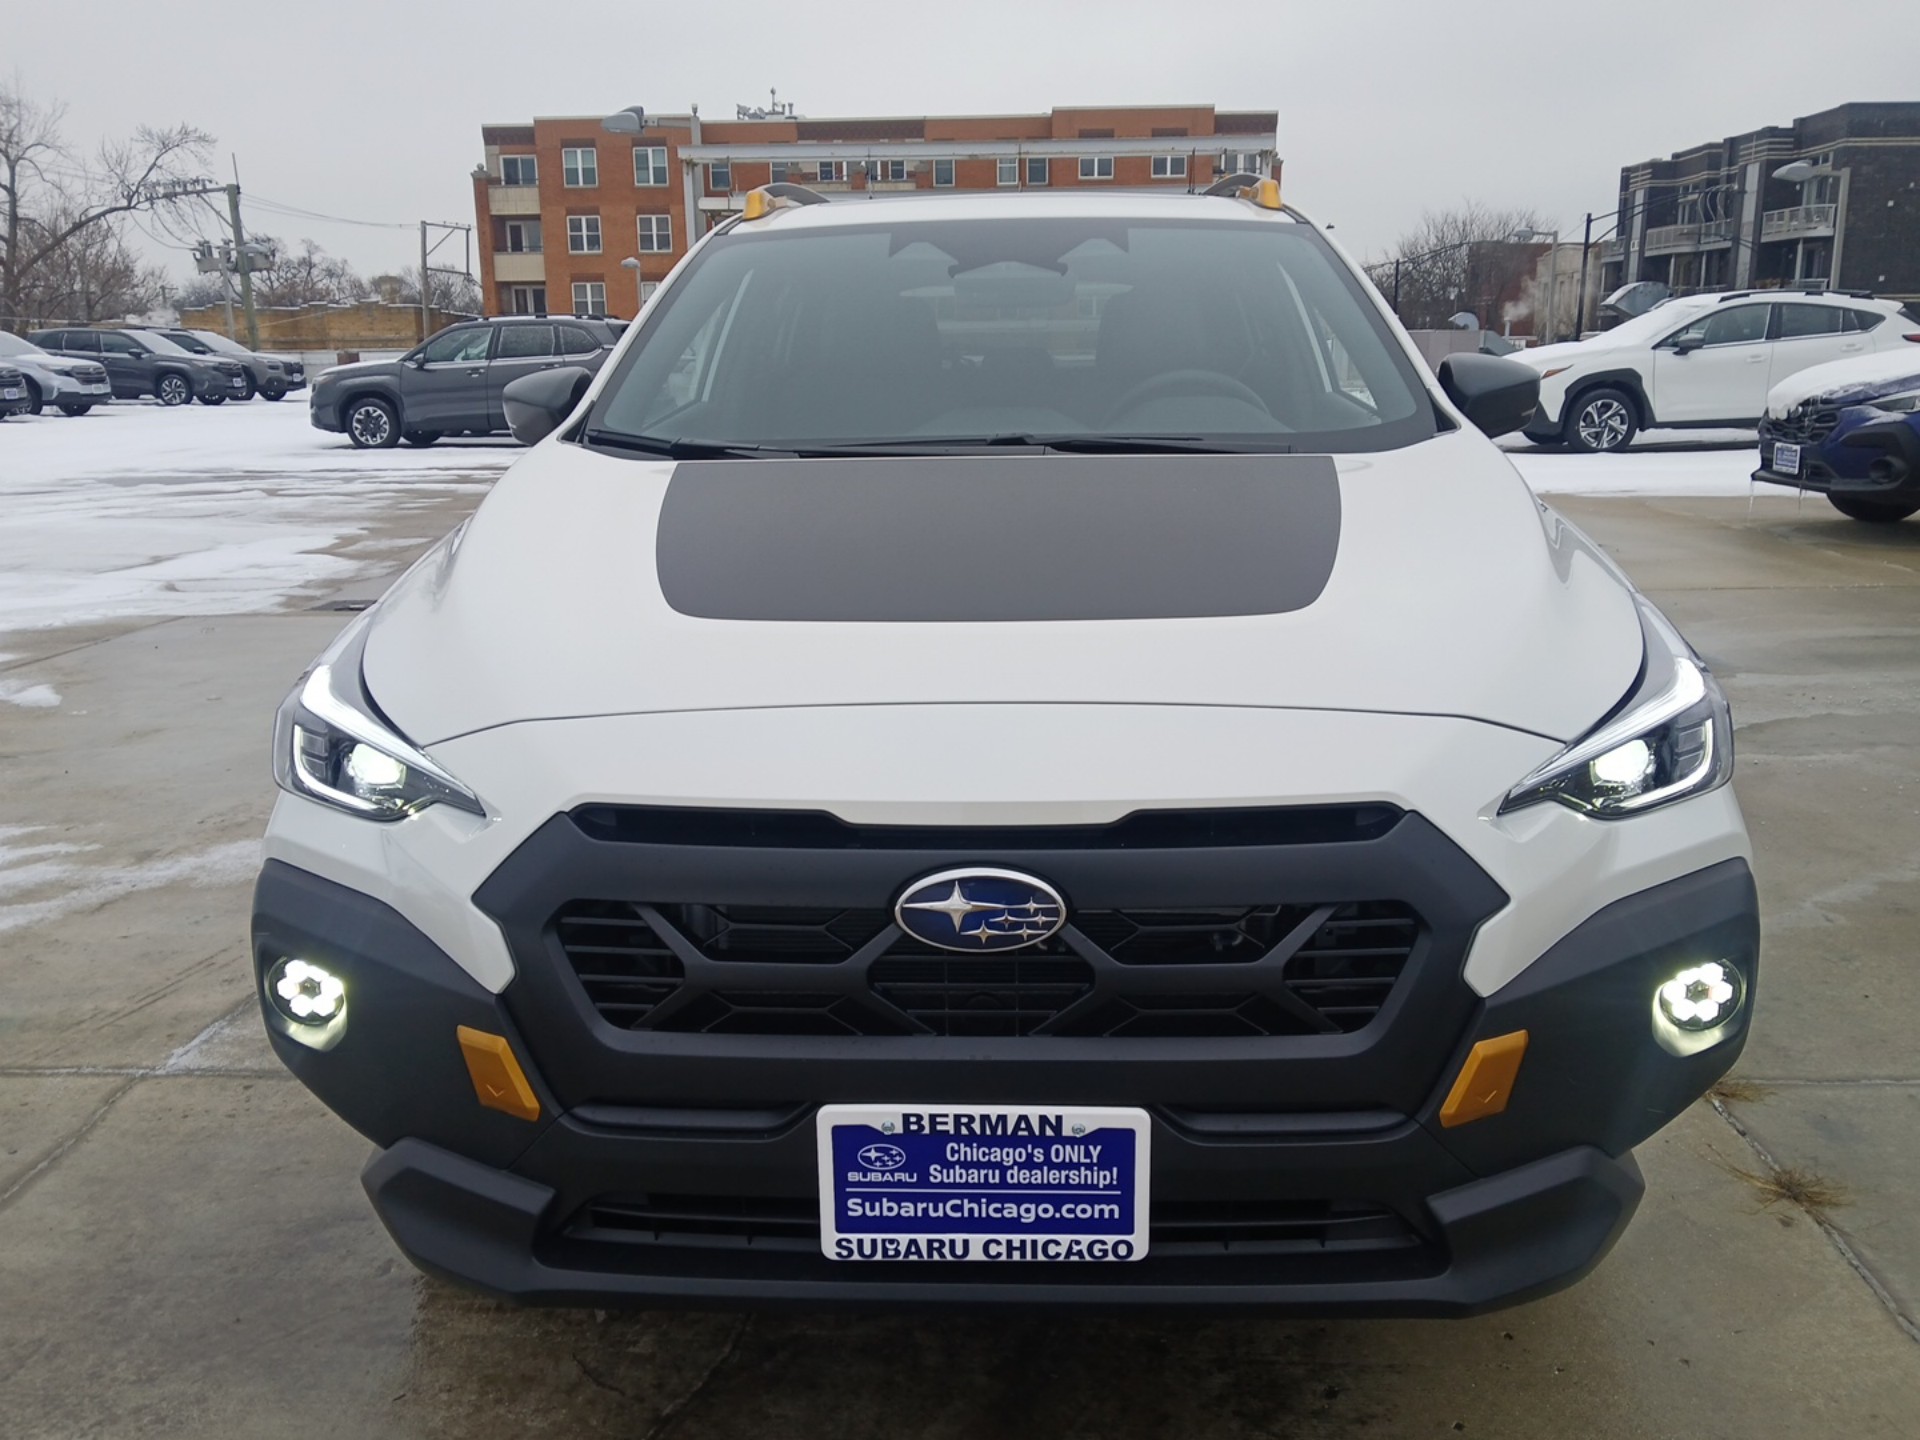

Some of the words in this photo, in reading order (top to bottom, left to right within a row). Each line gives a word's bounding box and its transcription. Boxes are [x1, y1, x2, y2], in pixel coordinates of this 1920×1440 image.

[901, 1113, 1064, 1137] BERMAN
[946, 1142, 1044, 1165] Chicago's
[1050, 1144, 1102, 1163] ONLY
[847, 1171, 917, 1183] SUBARU
[929, 1164, 1000, 1184] Subaru
[1006, 1166, 1118, 1188] dealership!
[847, 1198, 1120, 1223] SubaruChicago.com
[834, 1237, 970, 1260] SUBARU
[982, 1238, 1135, 1261] CHICAGO
